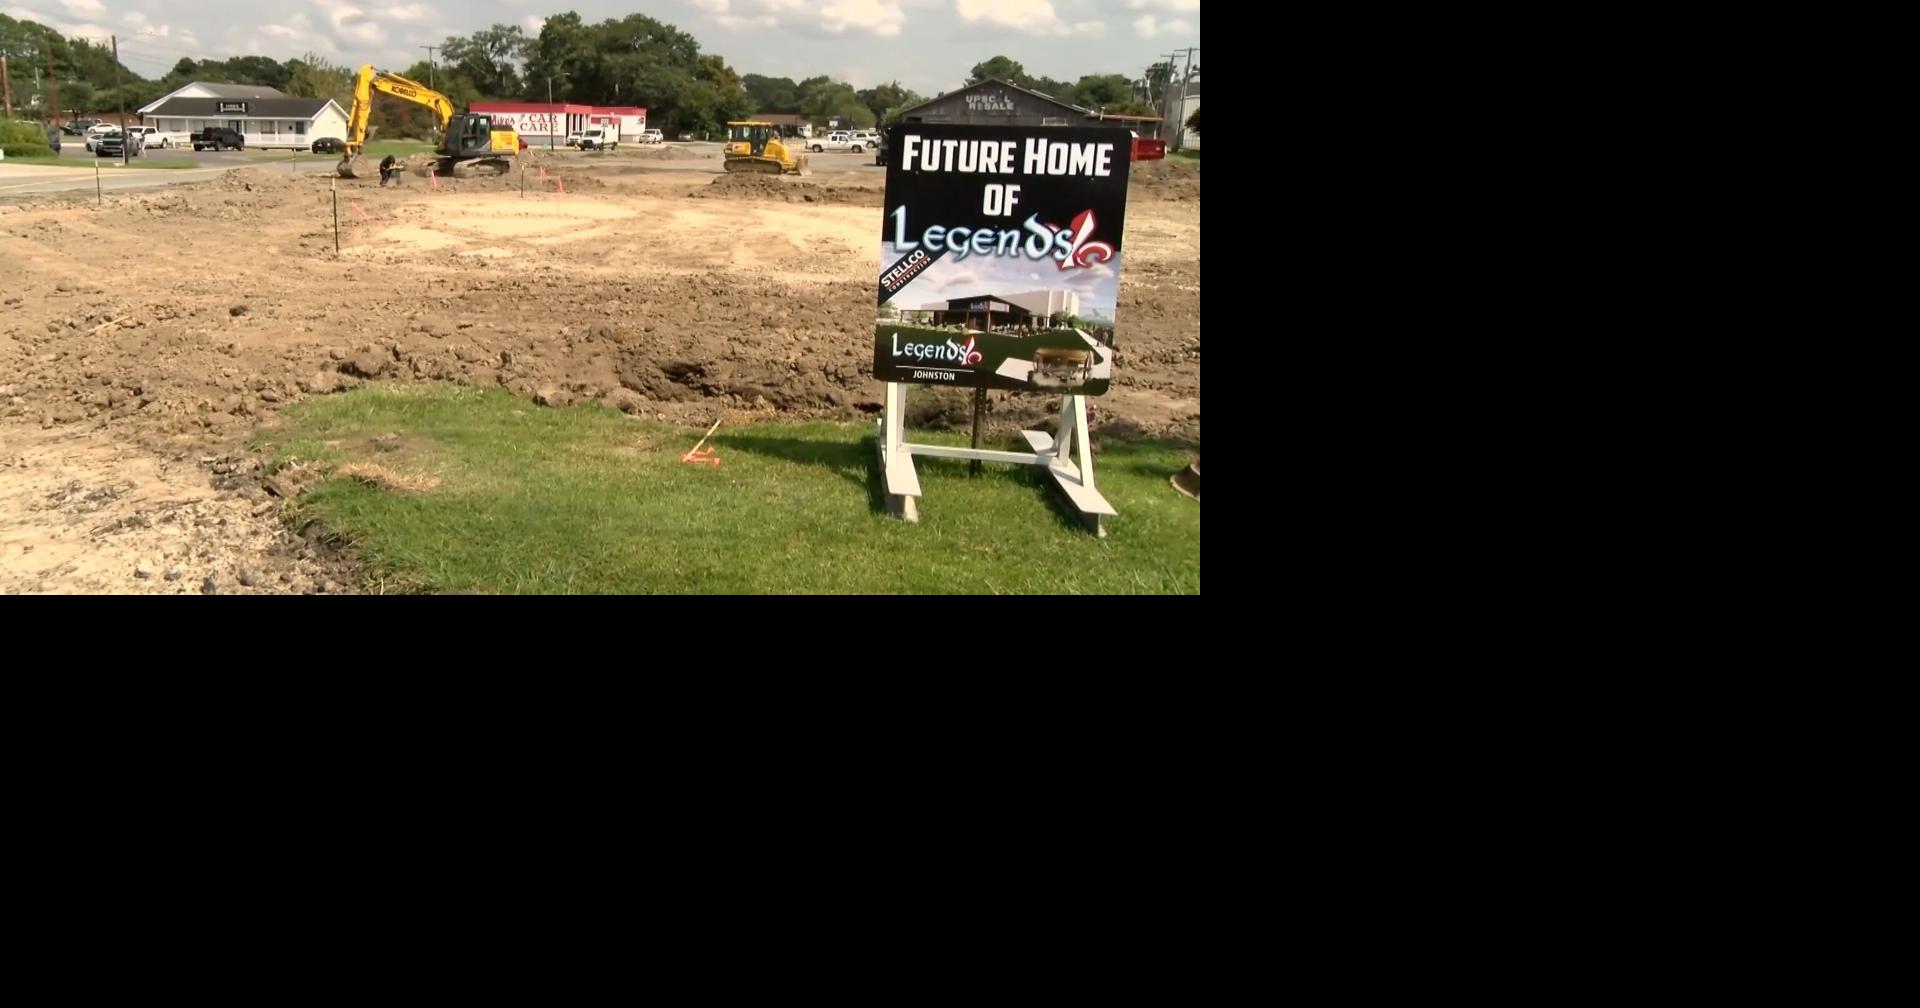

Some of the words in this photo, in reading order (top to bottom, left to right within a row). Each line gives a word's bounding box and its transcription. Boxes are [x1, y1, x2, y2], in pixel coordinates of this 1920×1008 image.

[529, 113, 559, 123] CAR
[902, 134, 1017, 174] FUTURE
[1023, 138, 1114, 176] HOME
[983, 183, 1021, 217] OF
[881, 250, 925, 287] STELLCO
[913, 370, 956, 381] JOHNSTON
